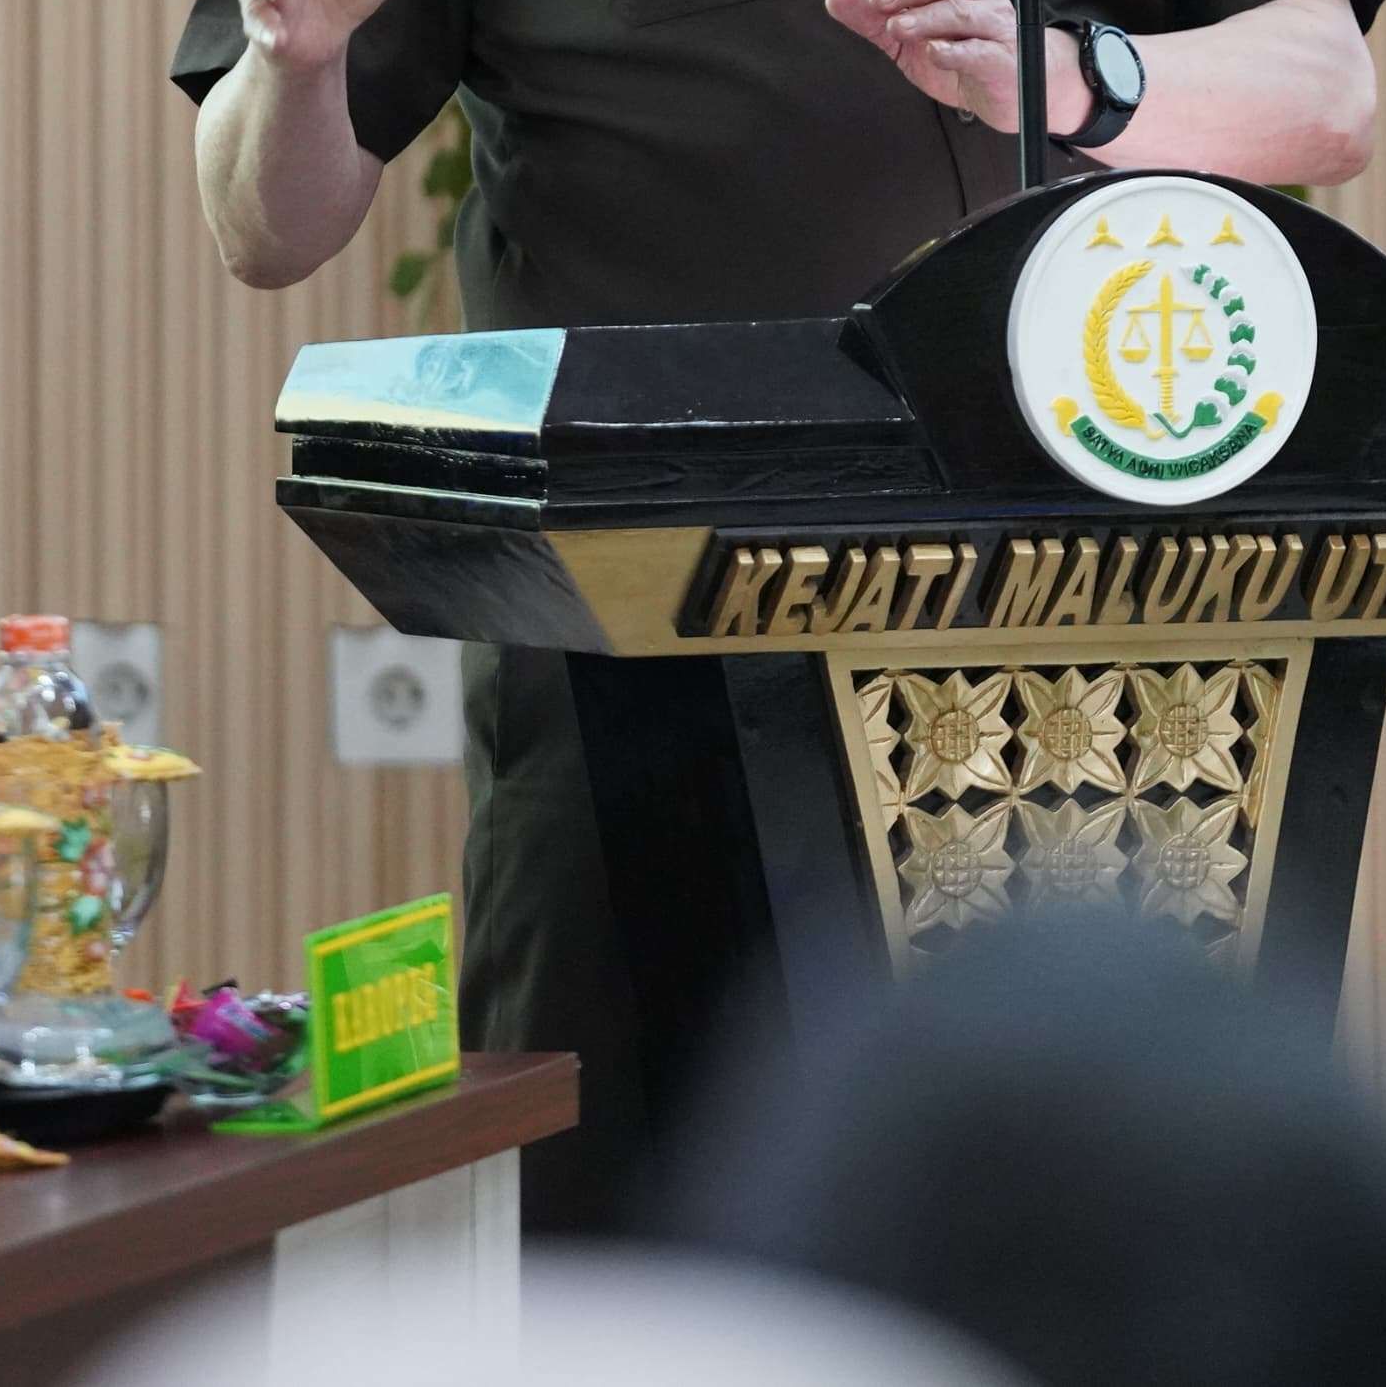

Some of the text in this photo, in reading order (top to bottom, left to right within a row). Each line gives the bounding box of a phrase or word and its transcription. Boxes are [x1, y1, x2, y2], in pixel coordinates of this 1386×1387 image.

[1082, 425, 1124, 464] SATYA
[712, 542, 978, 638] KEJATI
[987, 533, 1303, 628] MALUKU
